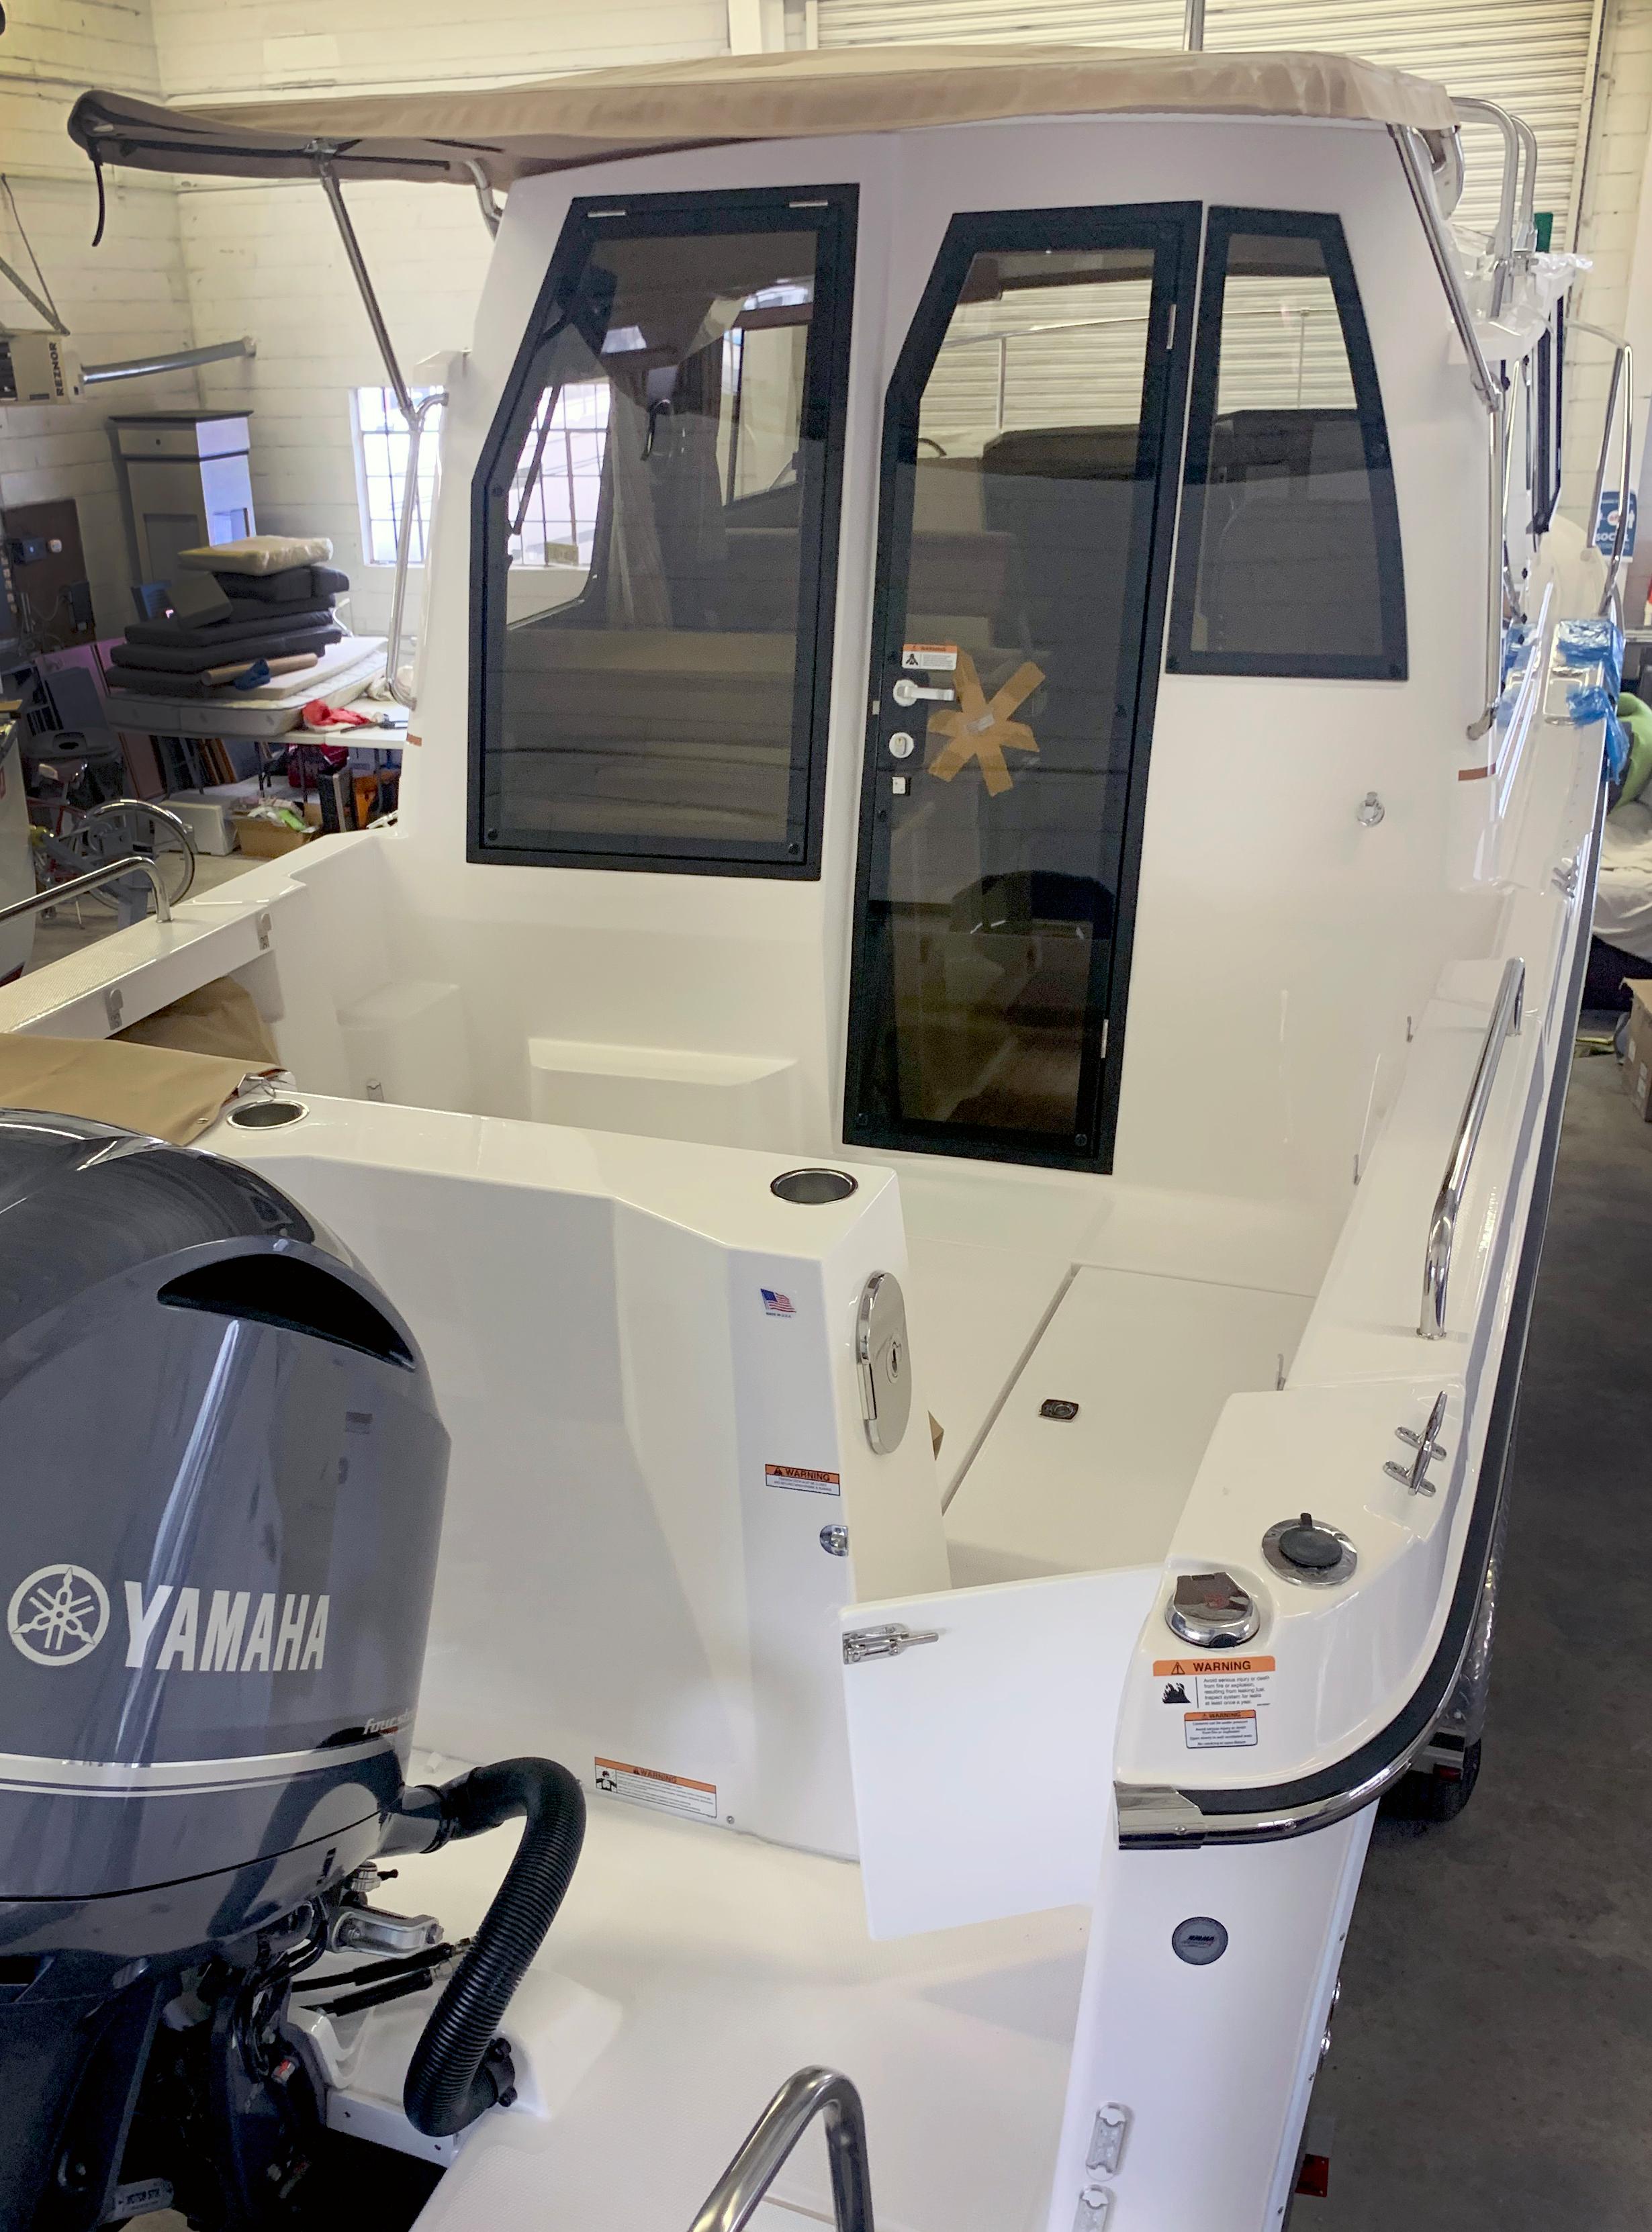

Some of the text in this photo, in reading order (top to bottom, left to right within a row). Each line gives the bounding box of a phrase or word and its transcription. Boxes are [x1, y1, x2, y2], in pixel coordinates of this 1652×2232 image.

[49, 342, 64, 396] REZNOR
[785, 1467, 831, 1481] WARNING
[124, 1580, 331, 1671] YAMAHA
[1193, 1661, 1252, 1672] WARNING
[639, 1768, 678, 1783] WARNING
